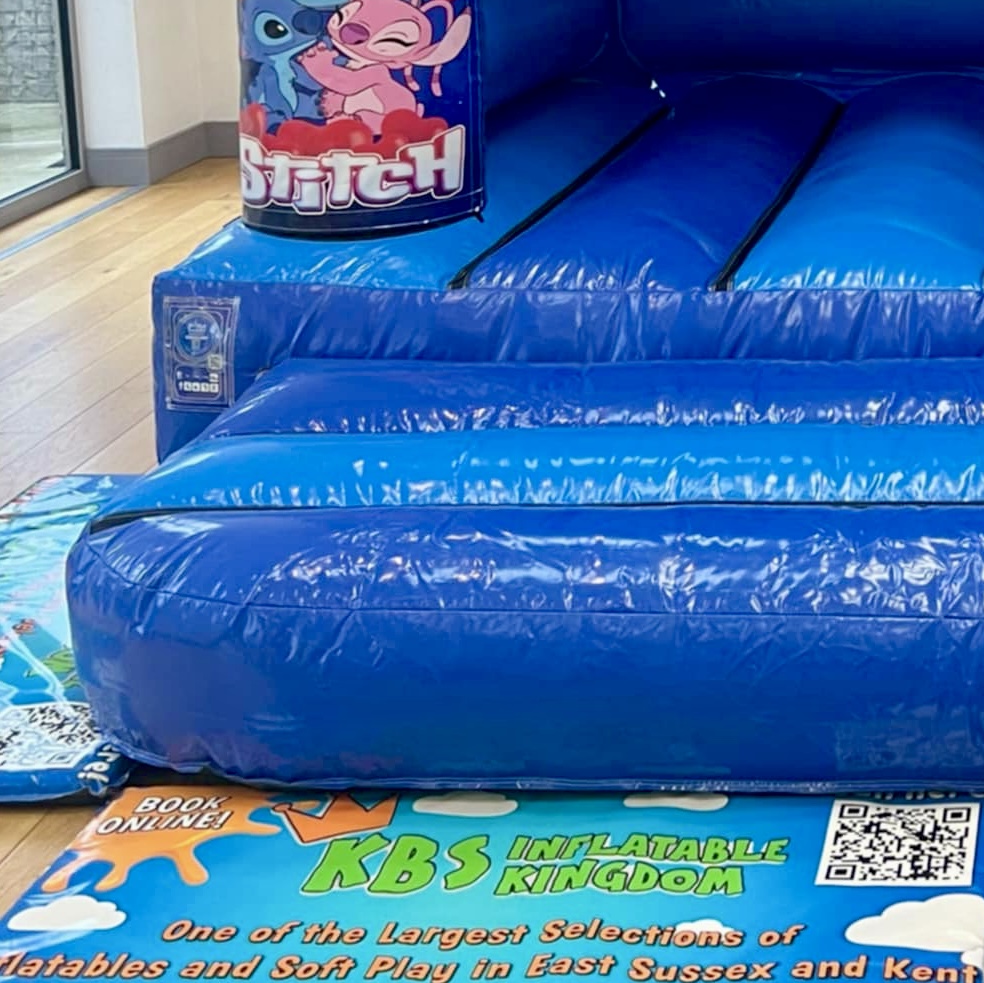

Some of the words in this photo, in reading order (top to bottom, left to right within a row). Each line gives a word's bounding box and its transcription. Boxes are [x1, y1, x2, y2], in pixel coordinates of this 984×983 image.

[136, 796, 231, 814] BOOK
[98, 810, 232, 835] ONLINE!
[506, 832, 790, 863] INFLATABLE
[300, 832, 492, 895] KBS
[494, 859, 745, 896] KINGDOM
[162, 920, 237, 942] One
[250, 921, 300, 943] of
[303, 921, 365, 944] the
[377, 921, 529, 950] Largest
[539, 919, 744, 947] Selections
[759, 924, 806, 947] of
[180, 955, 261, 980] and
[270, 955, 356, 979] Soft
[365, 955, 458, 983] Play
[471, 959, 508, 978] in
[525, 953, 615, 978] East
[629, 957, 774, 982] Sussex
[791, 955, 868, 979] and
[883, 956, 979, 983] Kent
